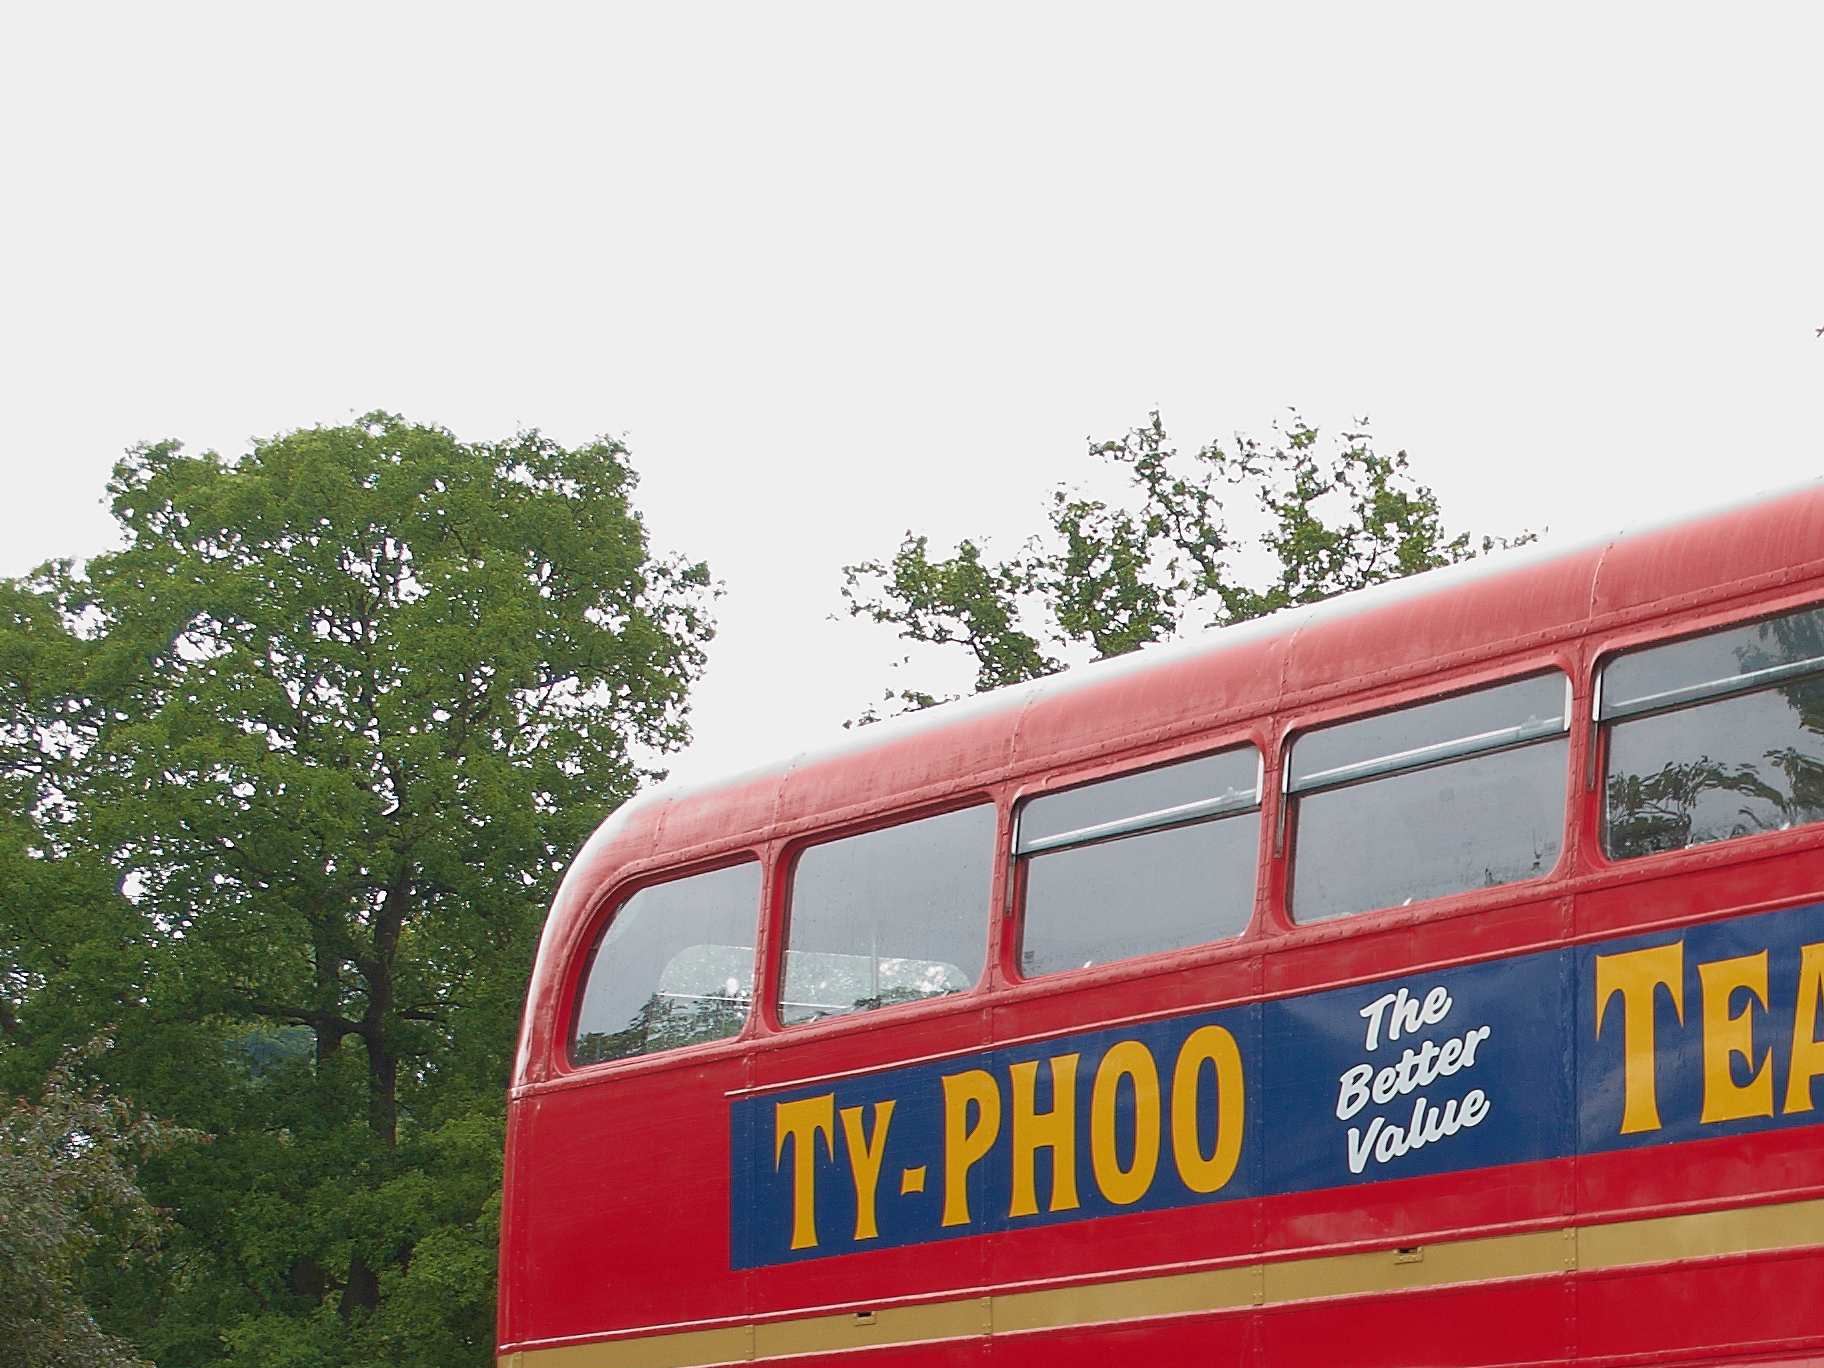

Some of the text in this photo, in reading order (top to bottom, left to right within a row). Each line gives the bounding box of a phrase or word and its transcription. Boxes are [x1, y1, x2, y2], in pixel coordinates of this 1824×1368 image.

[1360, 985, 1452, 1051] The
[1336, 1025, 1491, 1121] Better
[775, 1024, 1245, 1251] TY-PHOO
[1346, 1088, 1491, 1175] Value
